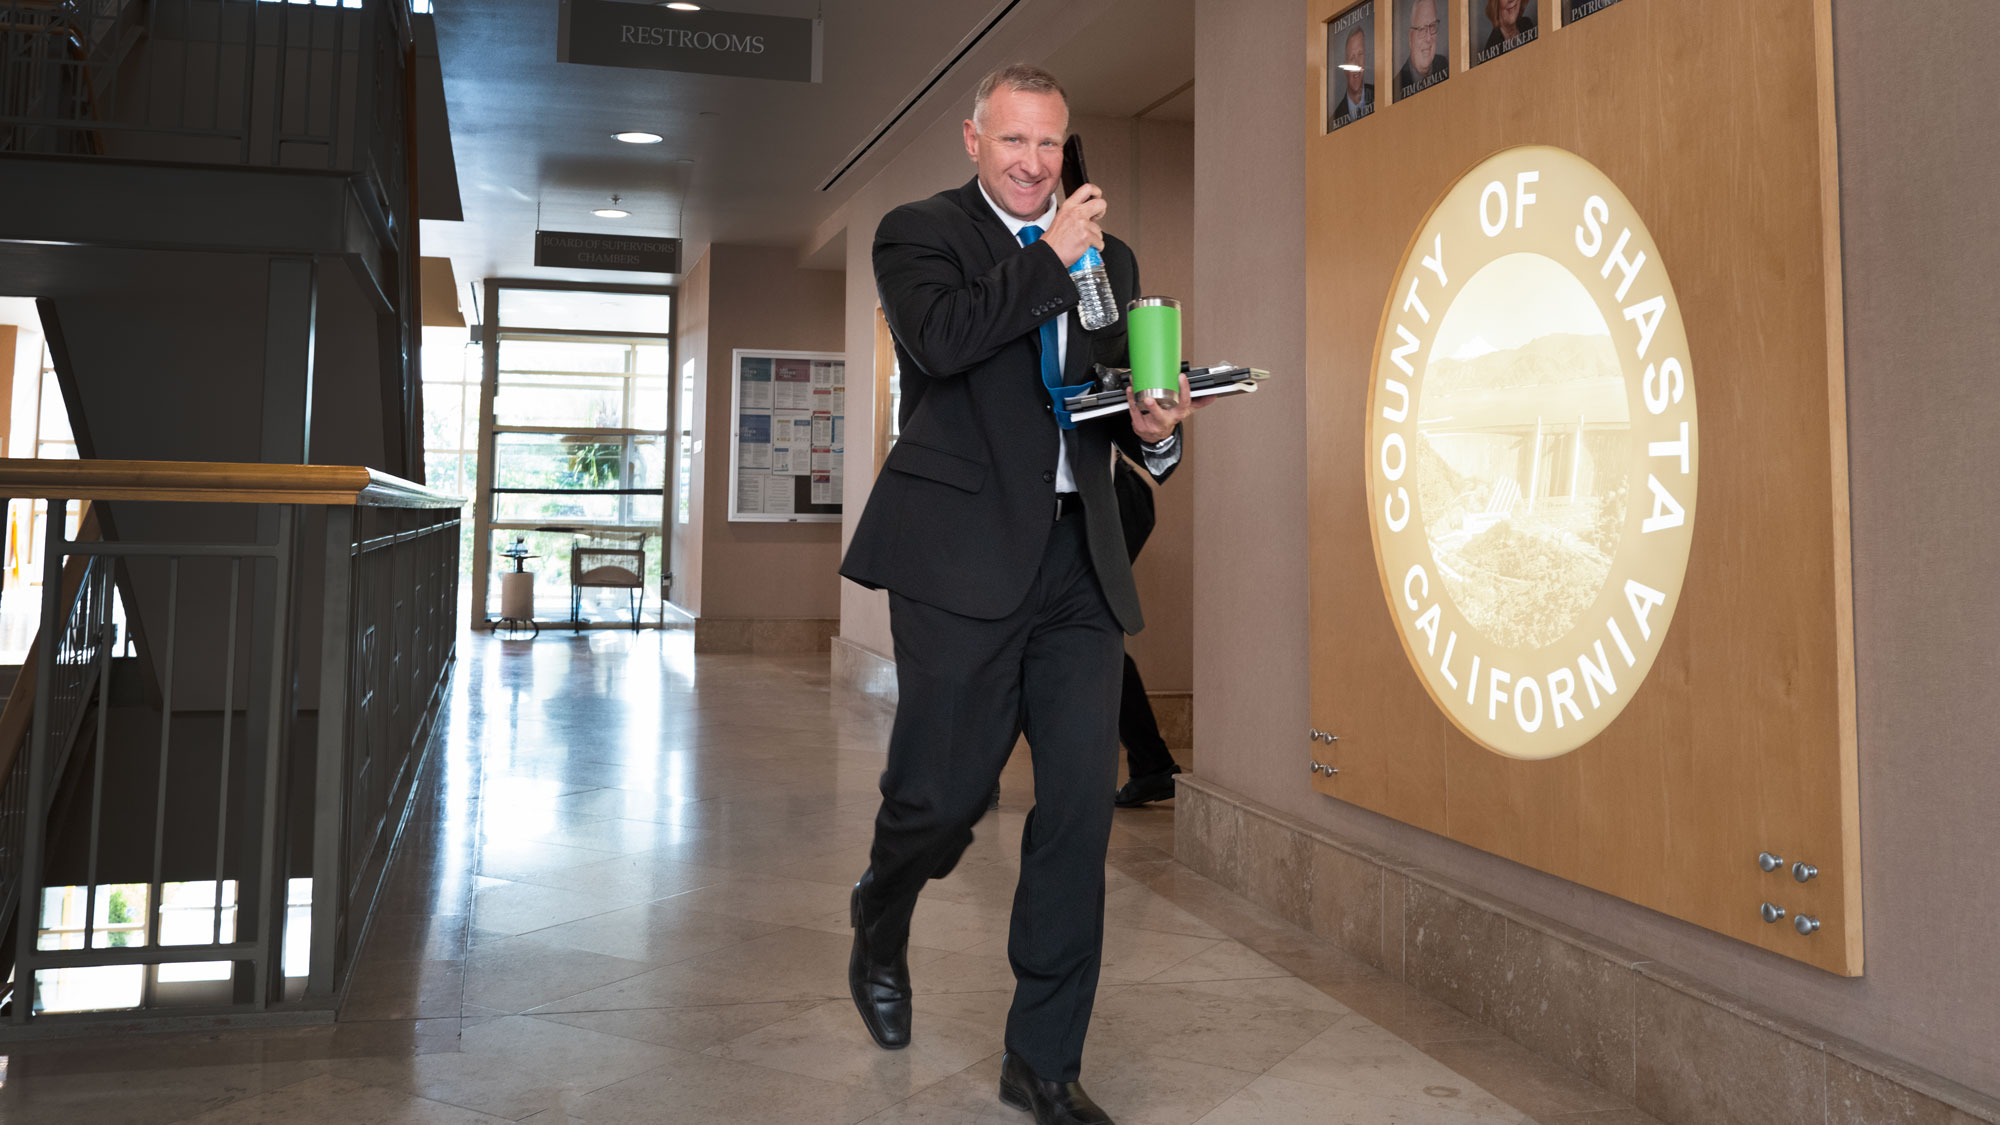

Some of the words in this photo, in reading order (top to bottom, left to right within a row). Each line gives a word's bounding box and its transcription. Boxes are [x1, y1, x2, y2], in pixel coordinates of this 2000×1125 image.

[1334, 2, 1371, 34] DISTRICT
[620, 25, 765, 54] RESTROOMS
[1477, 43, 1501, 64] MARY
[1502, 27, 1537, 52] RICKERT
[1402, 83, 1416, 98] TIM
[1416, 68, 1448, 92] GARMAN
[543, 236, 582, 249] BOARD
[585, 239, 600, 249] OF
[601, 239, 675, 253] SUPERVISORS
[577, 251, 641, 265] CHAMBERS
[1381, 232, 1448, 533] COUNTY
[1479, 171, 1539, 237] OF
[1575, 195, 1690, 534] SHASTA
[1404, 564, 1666, 733] CALIFORNIA
